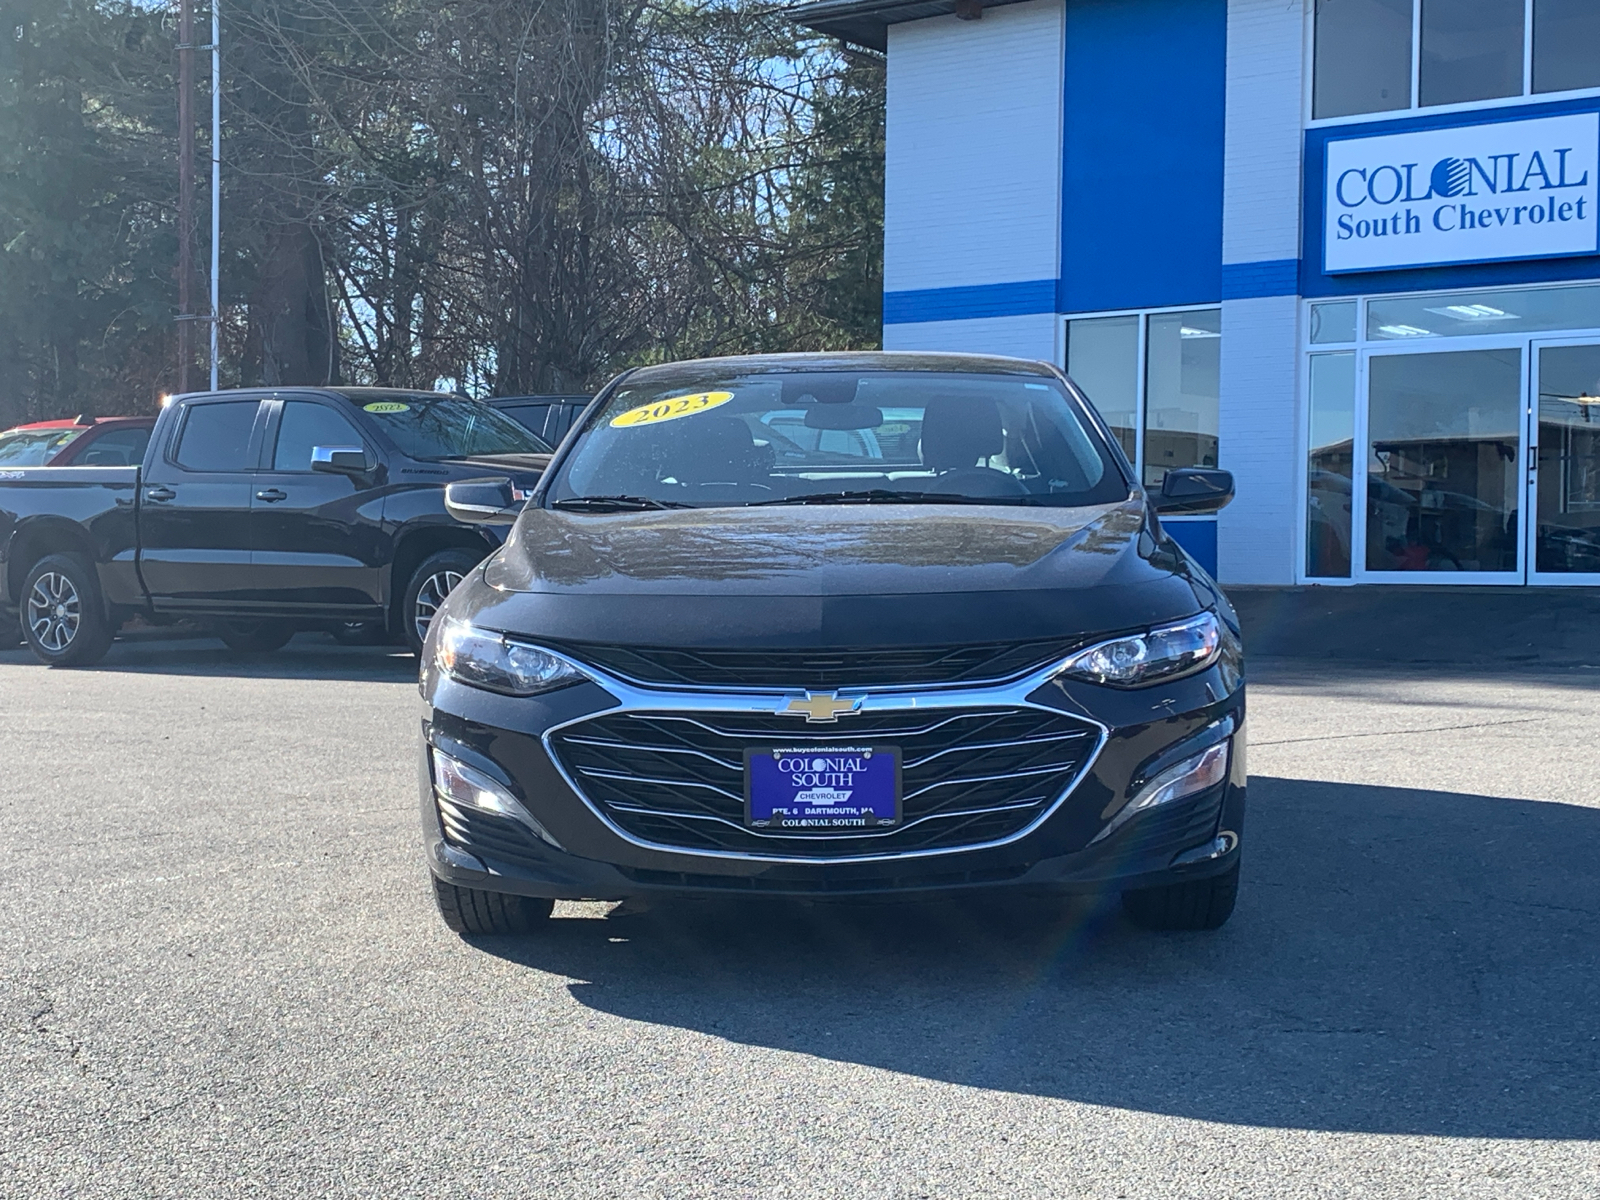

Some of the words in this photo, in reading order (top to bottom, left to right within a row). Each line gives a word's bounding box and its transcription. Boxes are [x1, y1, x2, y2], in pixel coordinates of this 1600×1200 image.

[1336, 148, 1588, 208] COLONIAL
[1337, 208, 1421, 240] South
[1432, 195, 1588, 232] Chevrolet
[634, 395, 710, 424] 2023
[778, 758, 867, 772] COLONIAL
[792, 773, 853, 787] SOUTH
[792, 807, 798, 815] 6
[805, 807, 859, 816] DARTMOUTH,
[782, 819, 831, 827] COLONIAL
